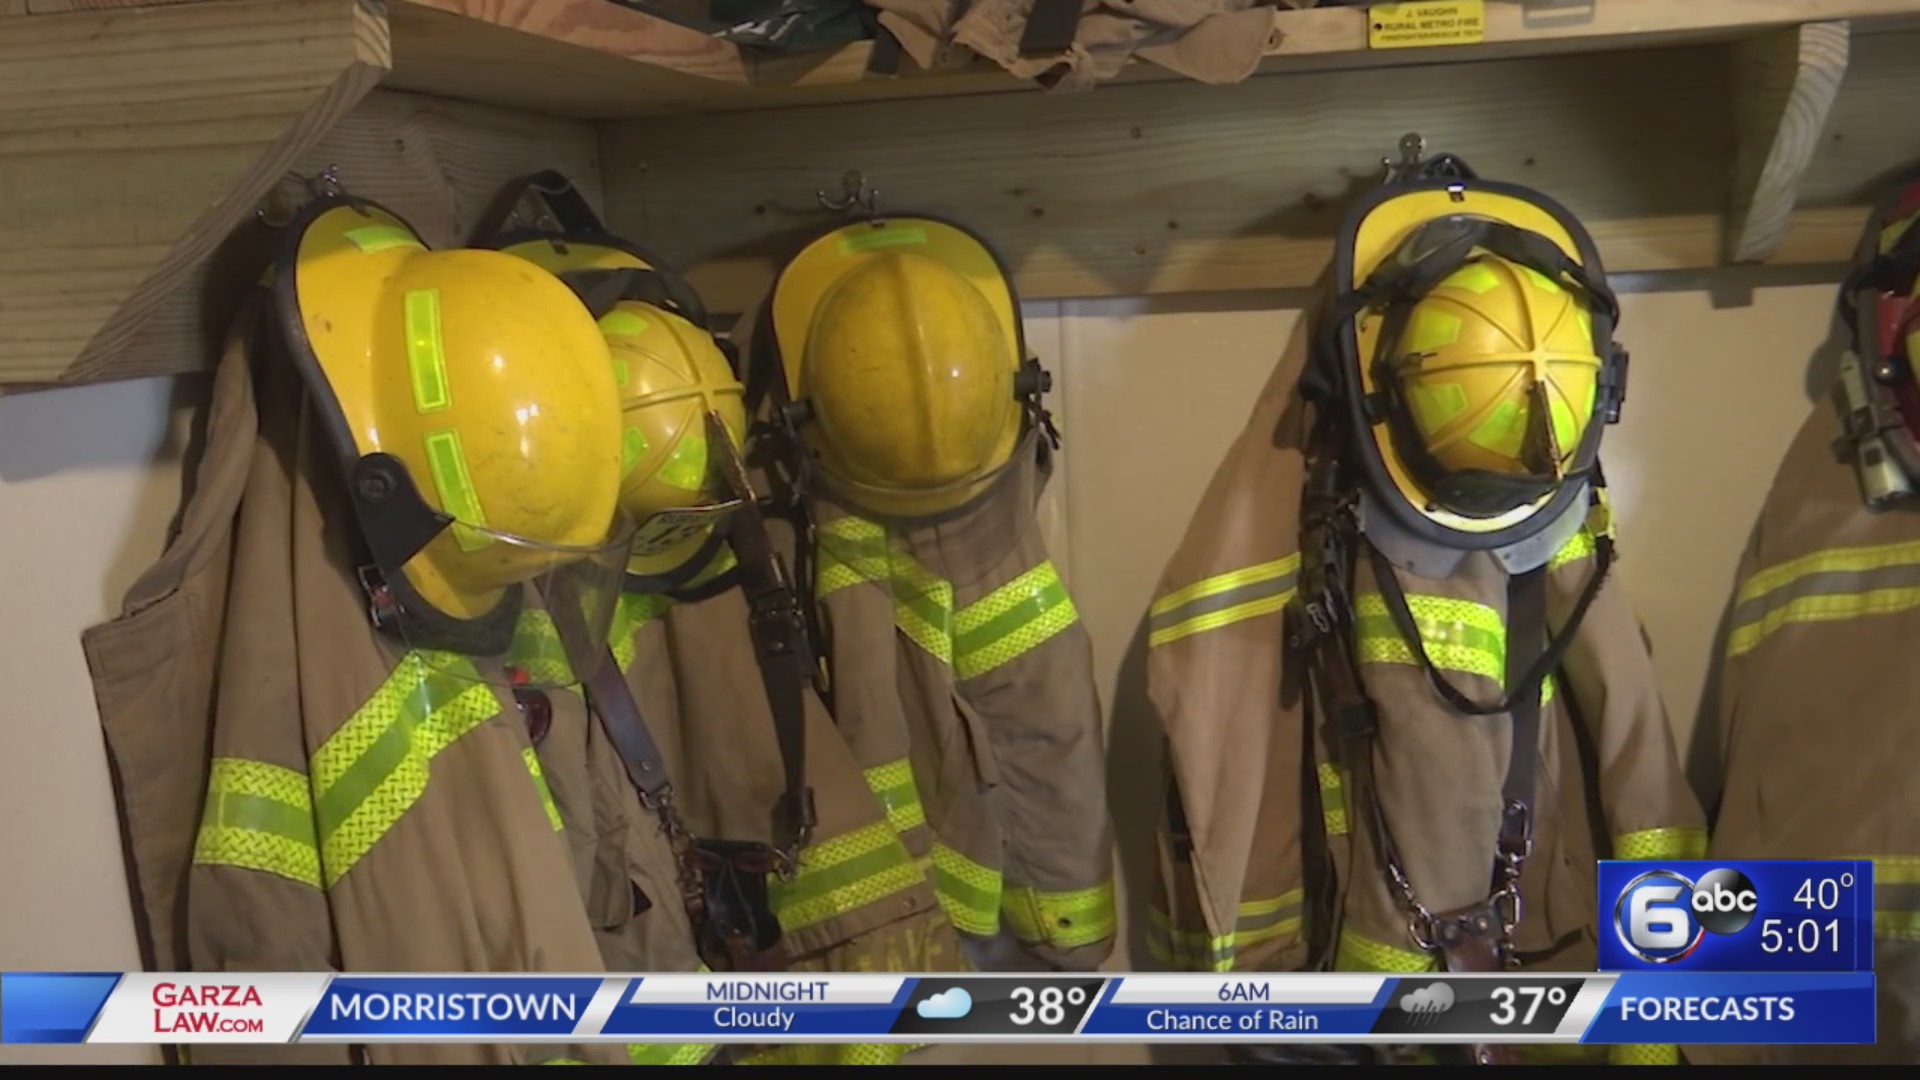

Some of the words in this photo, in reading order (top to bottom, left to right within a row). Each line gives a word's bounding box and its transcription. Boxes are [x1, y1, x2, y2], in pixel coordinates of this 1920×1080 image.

[1417, 7, 1458, 17] VAUGHN
[1384, 21, 1417, 30] RURAL
[1419, 19, 1456, 29] METRO
[1457, 18, 1480, 27] FIRE
